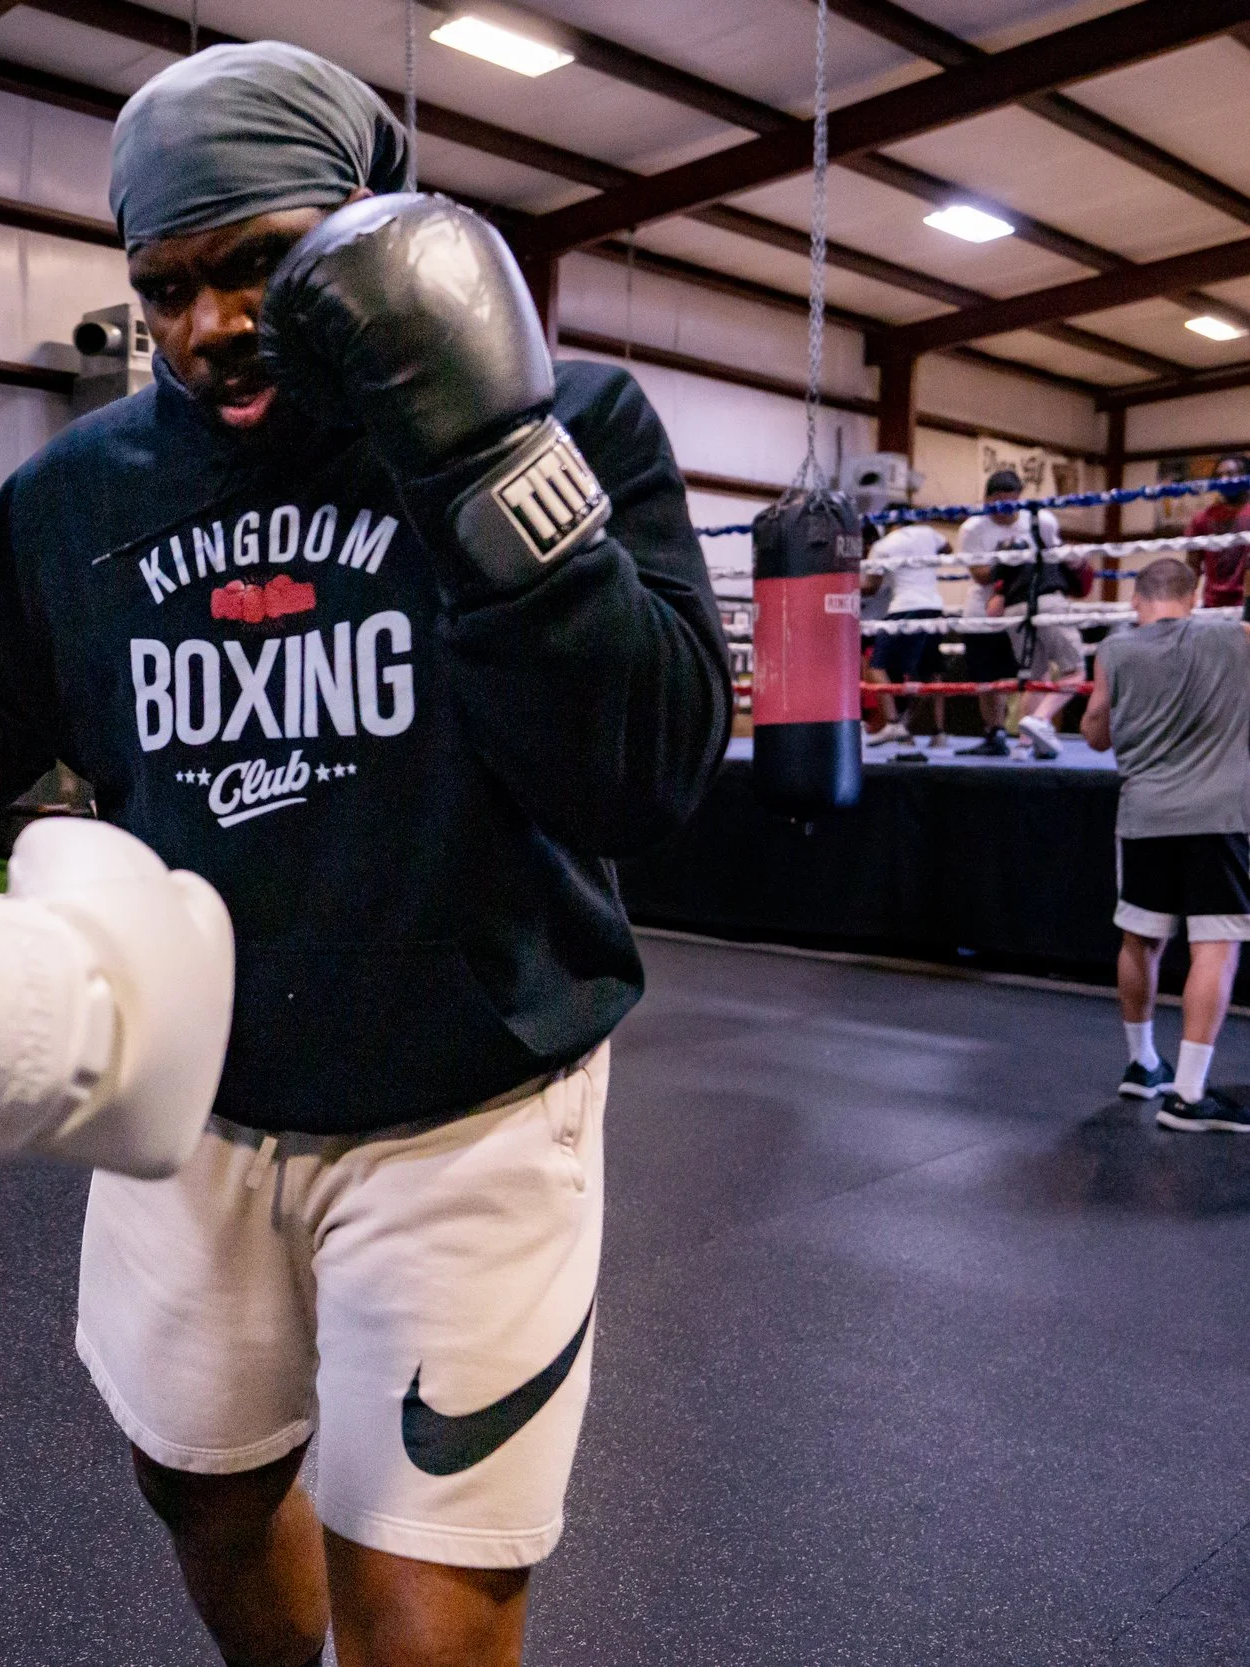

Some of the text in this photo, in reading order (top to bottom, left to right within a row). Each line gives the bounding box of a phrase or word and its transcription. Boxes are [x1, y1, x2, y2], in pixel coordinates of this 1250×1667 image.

[501, 438, 599, 540] TITL
[139, 504, 399, 604] KINGDOM
[130, 610, 415, 752] BOXING
[208, 749, 310, 817] Club
